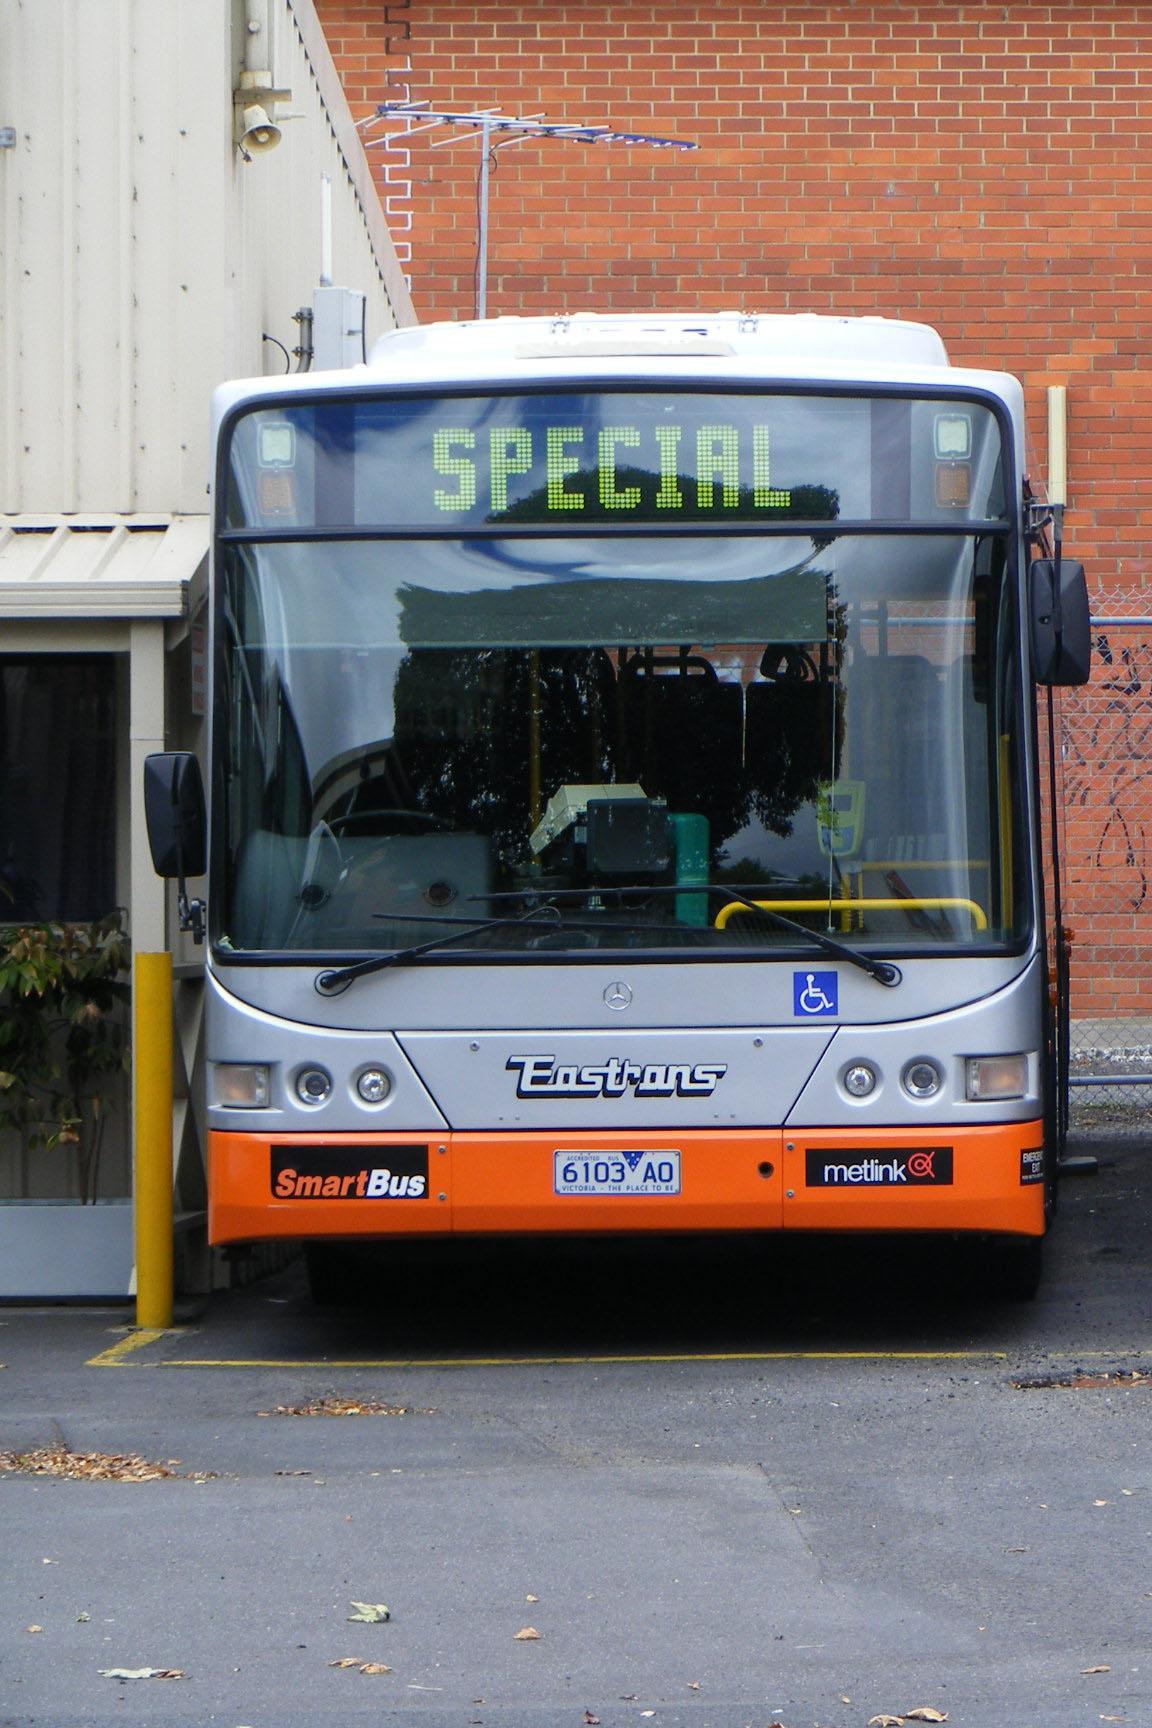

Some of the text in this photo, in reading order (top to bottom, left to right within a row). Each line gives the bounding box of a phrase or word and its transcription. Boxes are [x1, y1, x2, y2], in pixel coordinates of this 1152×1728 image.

[433, 425, 791, 511] SPECIAL
[505, 1054, 729, 1099] Eastrans
[274, 1168, 426, 1197] SmartBus
[562, 1161, 626, 1183] 6103
[824, 1159, 907, 1182] metlink
